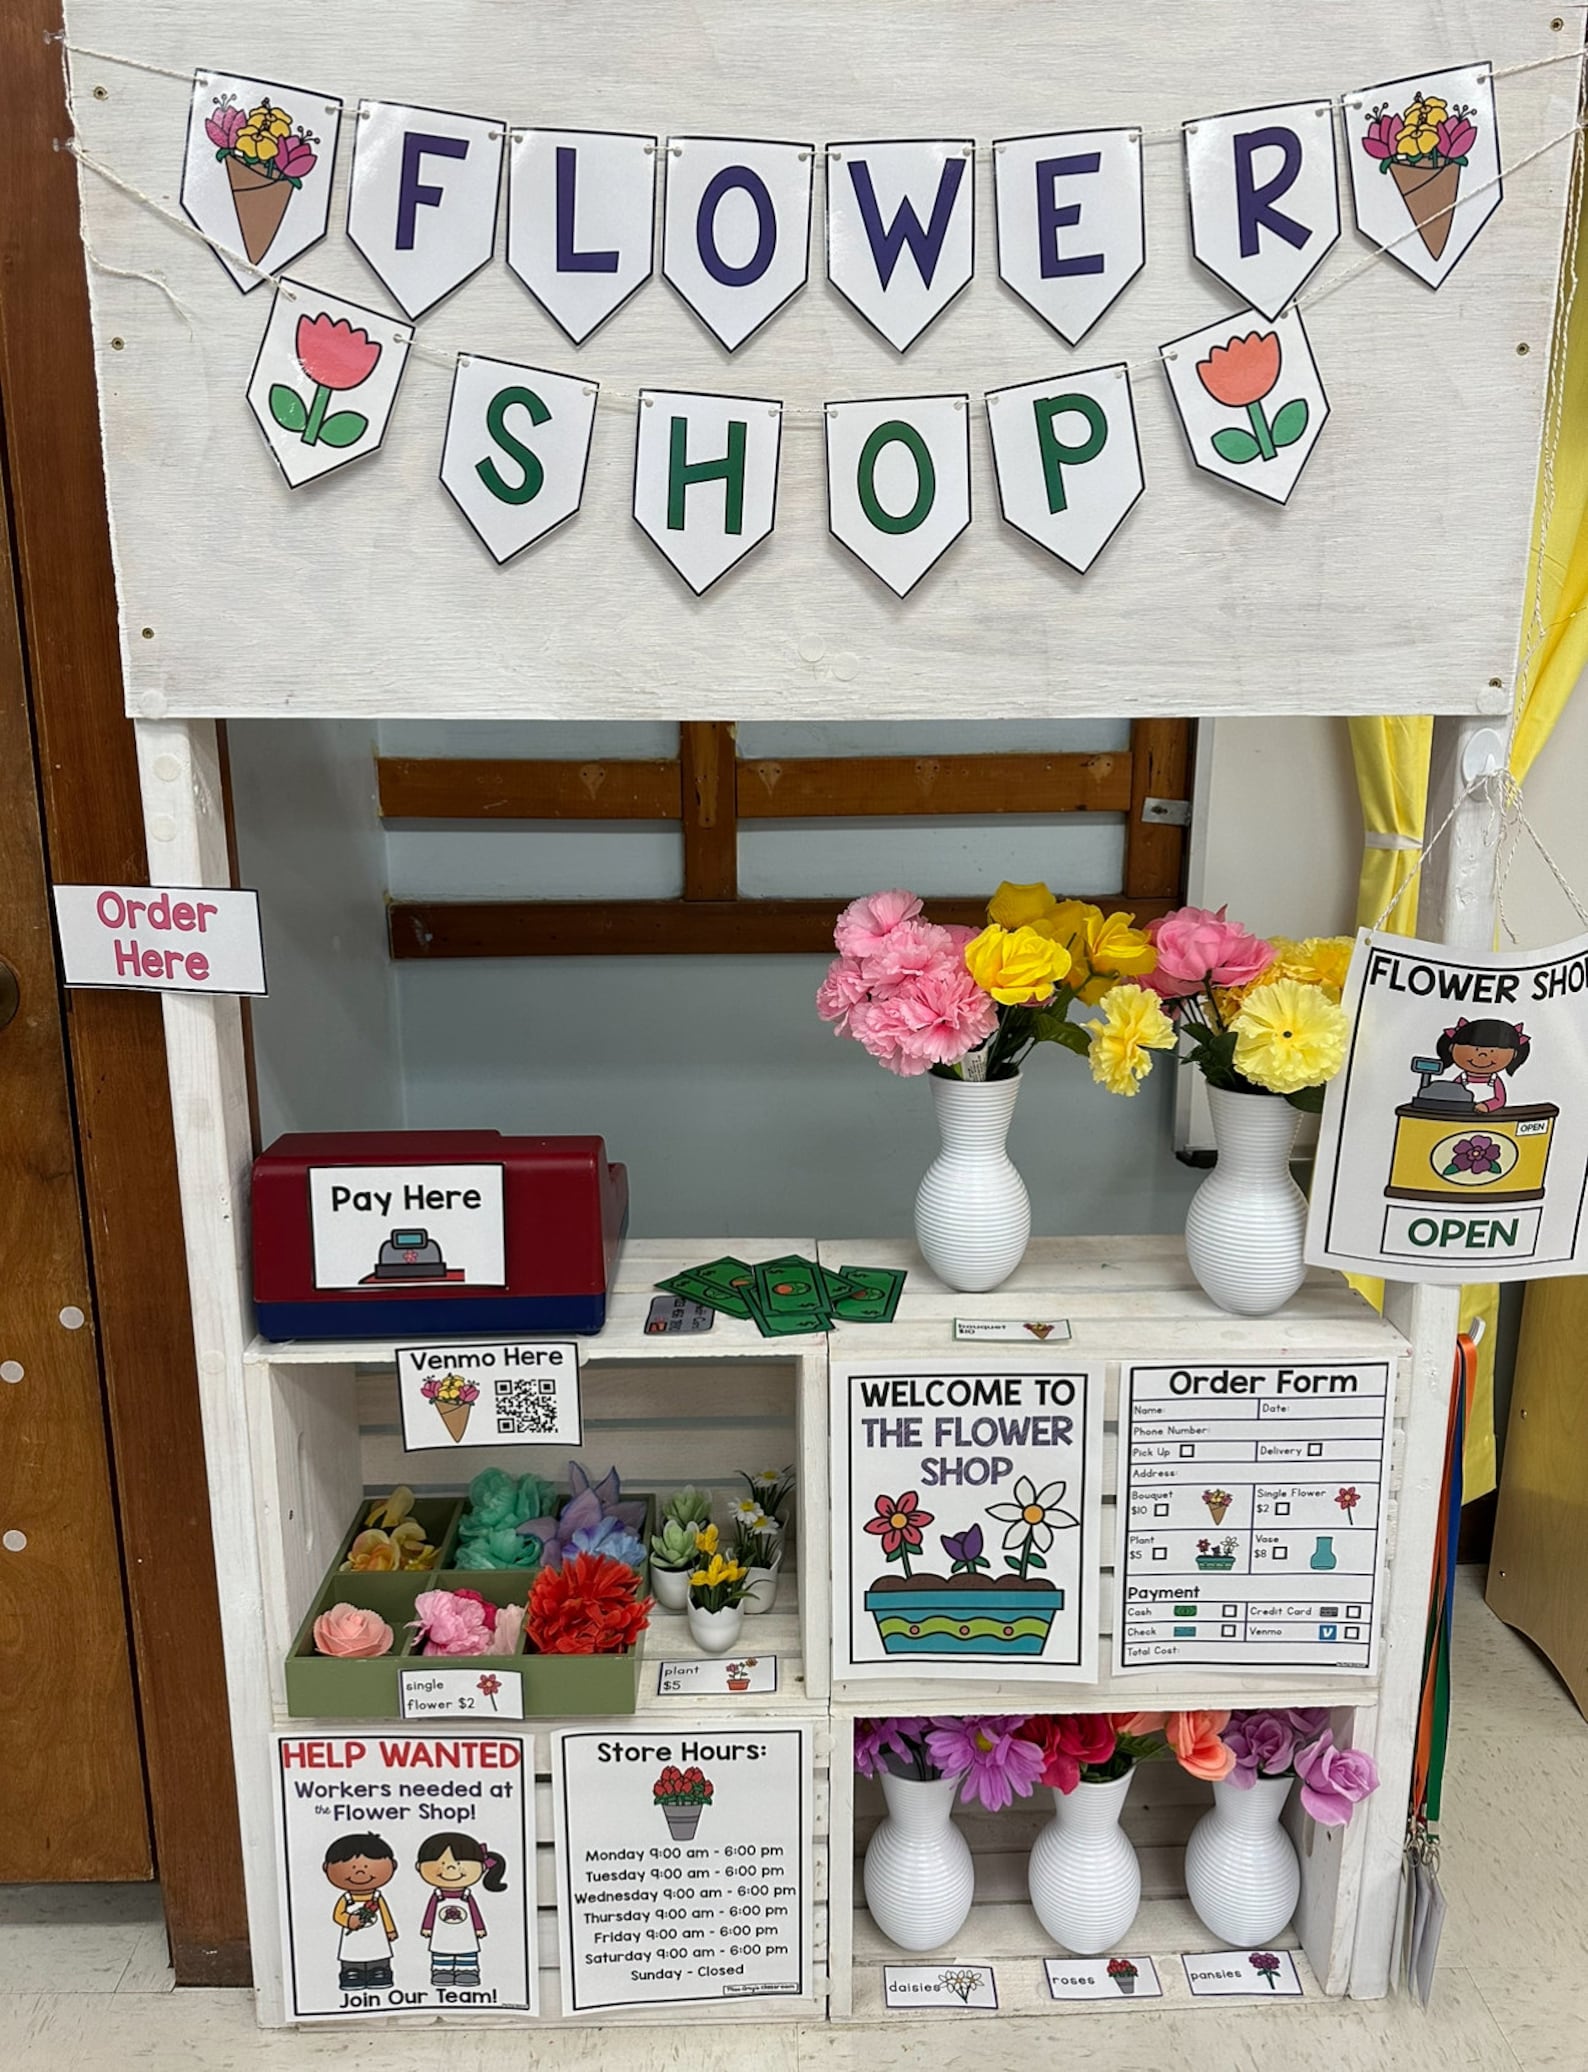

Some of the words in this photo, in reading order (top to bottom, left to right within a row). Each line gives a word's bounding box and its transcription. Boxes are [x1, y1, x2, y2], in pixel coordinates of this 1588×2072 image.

[395, 126, 1313, 292] FLOWER
[475, 386, 1108, 536] SHOP
[97, 890, 218, 933] Order
[114, 939, 210, 981] Here
[1369, 956, 1520, 1003] FLOWER
[1520, 1122, 1546, 1133] OPEN
[331, 1186, 392, 1216] Pay
[404, 1184, 482, 1210] Here
[1407, 1218, 1519, 1249] OPEN
[410, 1352, 496, 1371] Venmo
[504, 1347, 564, 1367] Here
[1169, 1370, 1266, 1395] Order
[1276, 1369, 1358, 1394] Form
[860, 1379, 1022, 1407] WELCOME
[1034, 1379, 1075, 1406] TO
[1134, 1405, 1165, 1415] Name:
[1262, 1403, 1290, 1413] Date:
[861, 1417, 923, 1448] THE
[935, 1416, 1073, 1447] FLOWER
[1133, 1426, 1165, 1436] Phone
[1132, 1447, 1154, 1457] Pick
[1157, 1447, 1171, 1458] Up
[1260, 1445, 1302, 1457] Delivery
[920, 1457, 1014, 1486] SHOP
[1132, 1468, 1178, 1478] Address:
[1131, 1490, 1174, 1502] Bouquet
[1257, 1488, 1287, 1499] Single
[1291, 1488, 1326, 1498] Flower
[1131, 1504, 1148, 1516] $10
[1256, 1503, 1270, 1515] $2
[1130, 1535, 1155, 1545] Plant
[1255, 1534, 1280, 1544] Vase
[1129, 1549, 1143, 1560] $5
[1254, 1548, 1267, 1559] $8
[1128, 1585, 1200, 1601] Payment
[1127, 1608, 1152, 1617] Cash
[1250, 1606, 1283, 1616] Credit
[1287, 1606, 1312, 1616] Card
[1127, 1627, 1157, 1637] Check
[1250, 1627, 1283, 1637] Venmo
[1128, 1647, 1150, 1656] Total
[664, 1664, 700, 1678] plant
[406, 1678, 444, 1694] single
[663, 1680, 681, 1691] $5
[407, 1698, 453, 1712] flower
[458, 1697, 476, 1711] $2
[283, 1741, 367, 1769] HELP
[379, 1741, 521, 1769] WANTED
[597, 1742, 672, 1763] Store
[681, 1741, 767, 1762] Hours:
[294, 1781, 391, 1799] Workers
[399, 1781, 482, 1798] needed
[490, 1784, 514, 1798] at
[314, 1805, 331, 1816] the
[333, 1804, 411, 1821] Flower
[419, 1803, 476, 1823] Shop!
[585, 1848, 645, 1863] Monday
[650, 1847, 681, 1859] 9:00
[686, 1848, 709, 1858] am
[724, 1845, 756, 1857] 6:00
[761, 1846, 784, 1859] pm
[586, 1868, 645, 1884] Tuesday
[650, 1868, 682, 1880] 9:00
[687, 1868, 710, 1879] am
[725, 1865, 757, 1877] 6:00
[761, 1867, 784, 1879] pm
[574, 1889, 658, 1905] Wednesday
[663, 1887, 695, 1900] 9:00
[700, 1888, 722, 1899] am
[737, 1885, 769, 1897] 6:00
[774, 1887, 797, 1899] pm
[584, 1909, 650, 1925] Thursday
[655, 1908, 687, 1920] 9:00
[691, 1909, 714, 1919] am
[730, 1905, 761, 1917] 6:00
[765, 1906, 788, 1919] pm
[594, 1930, 641, 1945] Friday
[646, 1928, 678, 1940] 9:00
[682, 1929, 705, 1939] am
[720, 1925, 751, 1937] 6:00
[756, 1926, 778, 1939] pm
[585, 1951, 651, 1965] Saturday
[656, 1948, 688, 1960] 9:00
[692, 1948, 715, 1958] am
[730, 1944, 761, 1957] 6:00
[766, 1946, 788, 1958] pm
[631, 1968, 682, 1982] Sunday
[697, 1964, 745, 1978] Closed
[1052, 1974, 1095, 1986] roses
[1191, 1968, 1242, 1983] pansies
[888, 1980, 941, 1993] daisies
[339, 1993, 381, 2009] Join
[388, 1989, 428, 2005] Our
[436, 1988, 498, 2005] Team!
